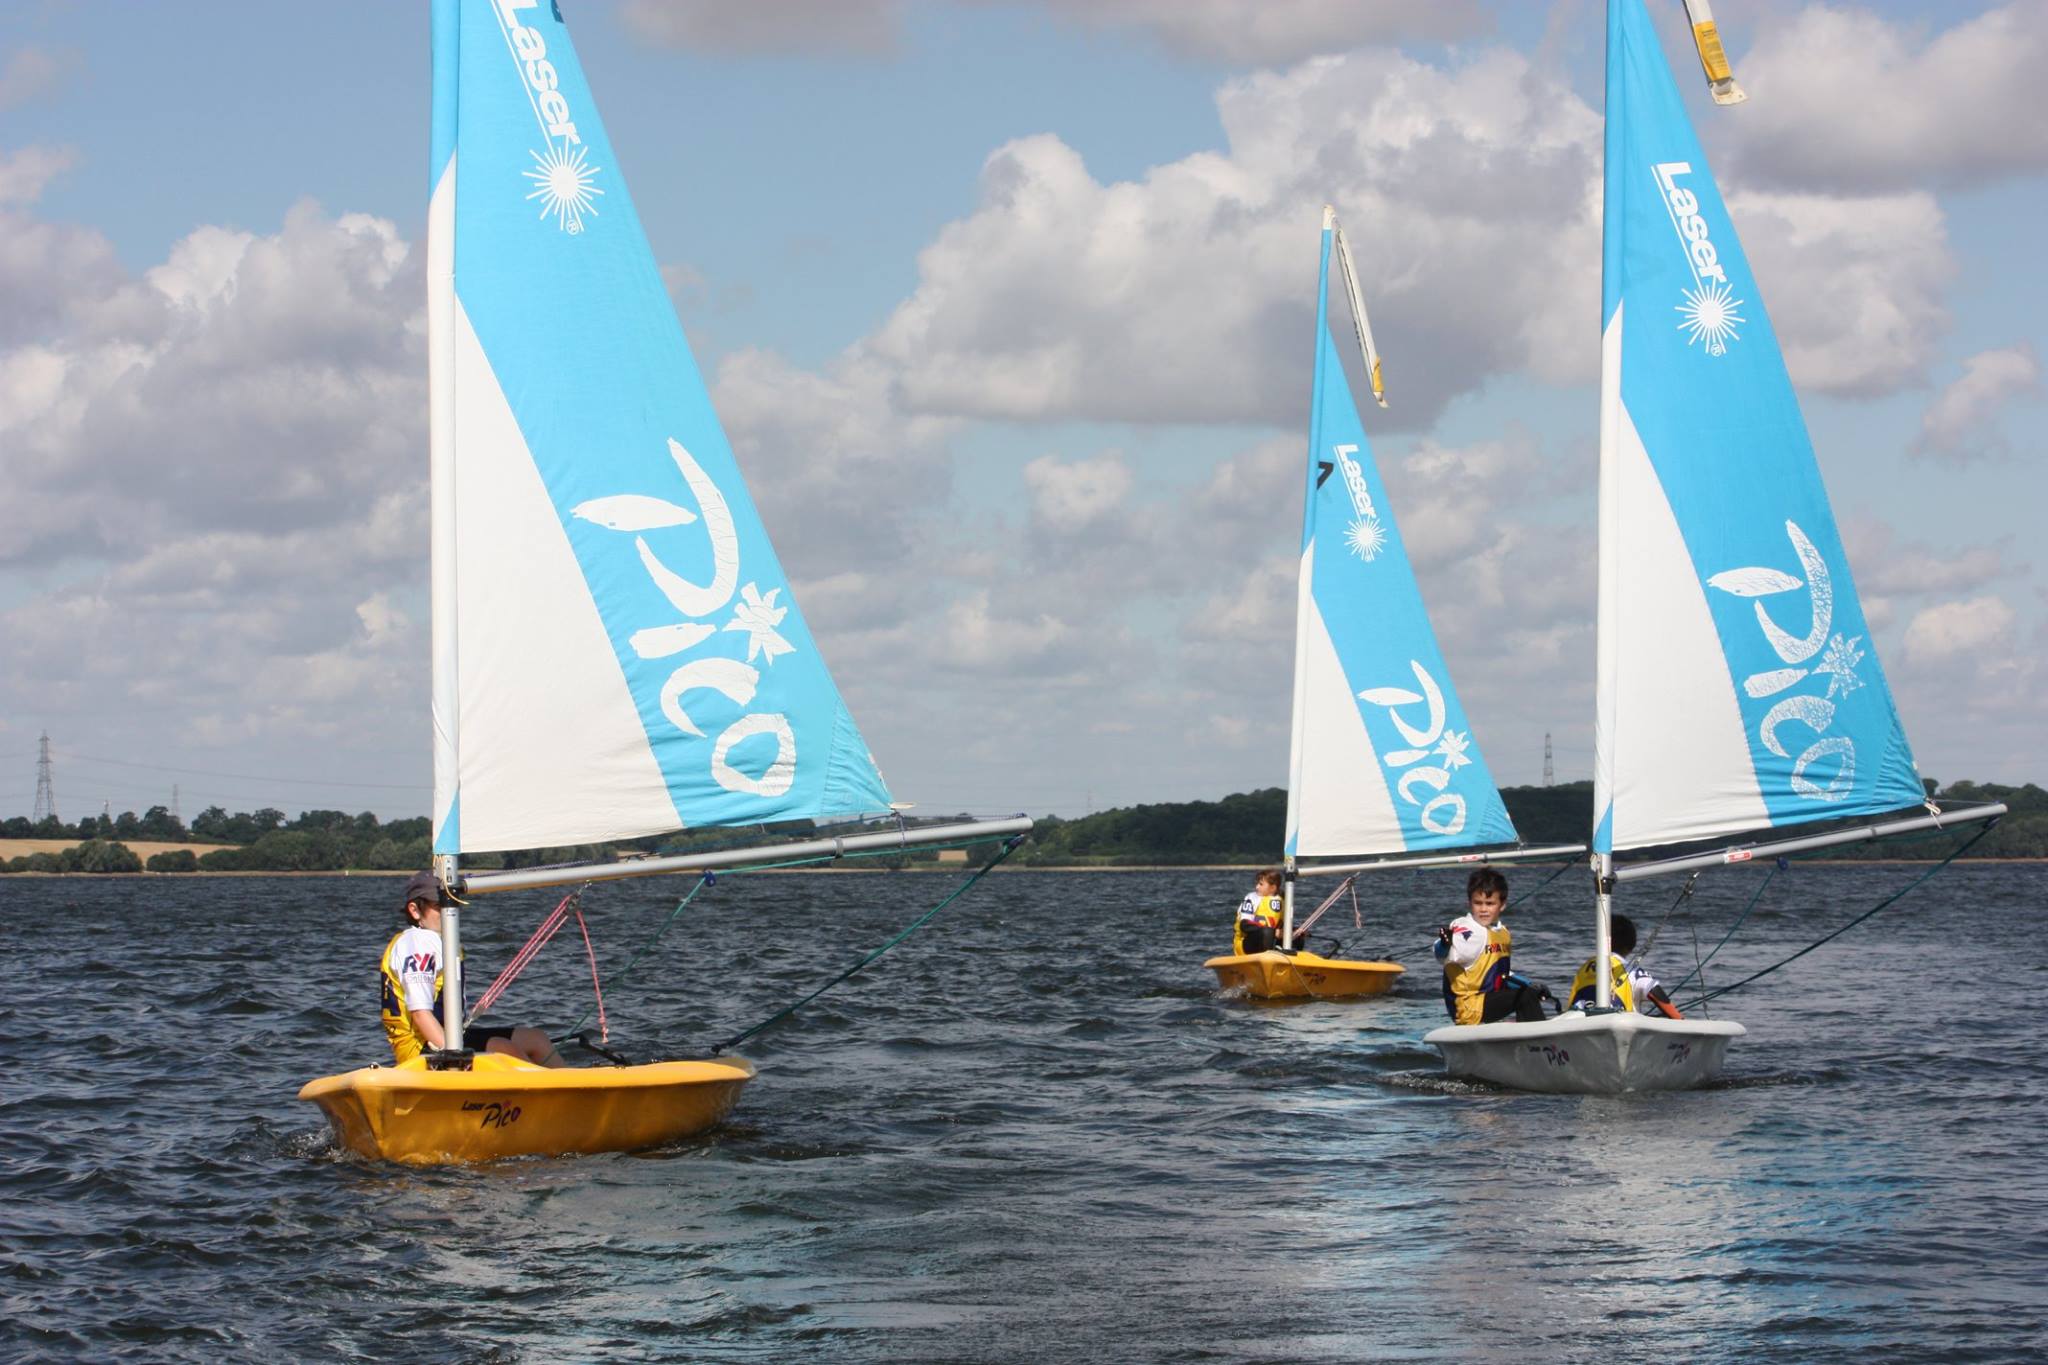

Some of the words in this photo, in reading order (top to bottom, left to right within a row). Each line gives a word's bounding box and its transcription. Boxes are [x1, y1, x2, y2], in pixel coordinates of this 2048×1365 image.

[500, 0, 581, 144] Laser
[1655, 162, 1727, 283] Laser
[1336, 445, 1377, 518] Laser
[570, 437, 797, 797] Pico
[1707, 519, 1866, 802] Pico
[1357, 659, 1472, 835] Pico
[402, 952, 437, 975] RYA
[480, 1100, 522, 1129] Pico
